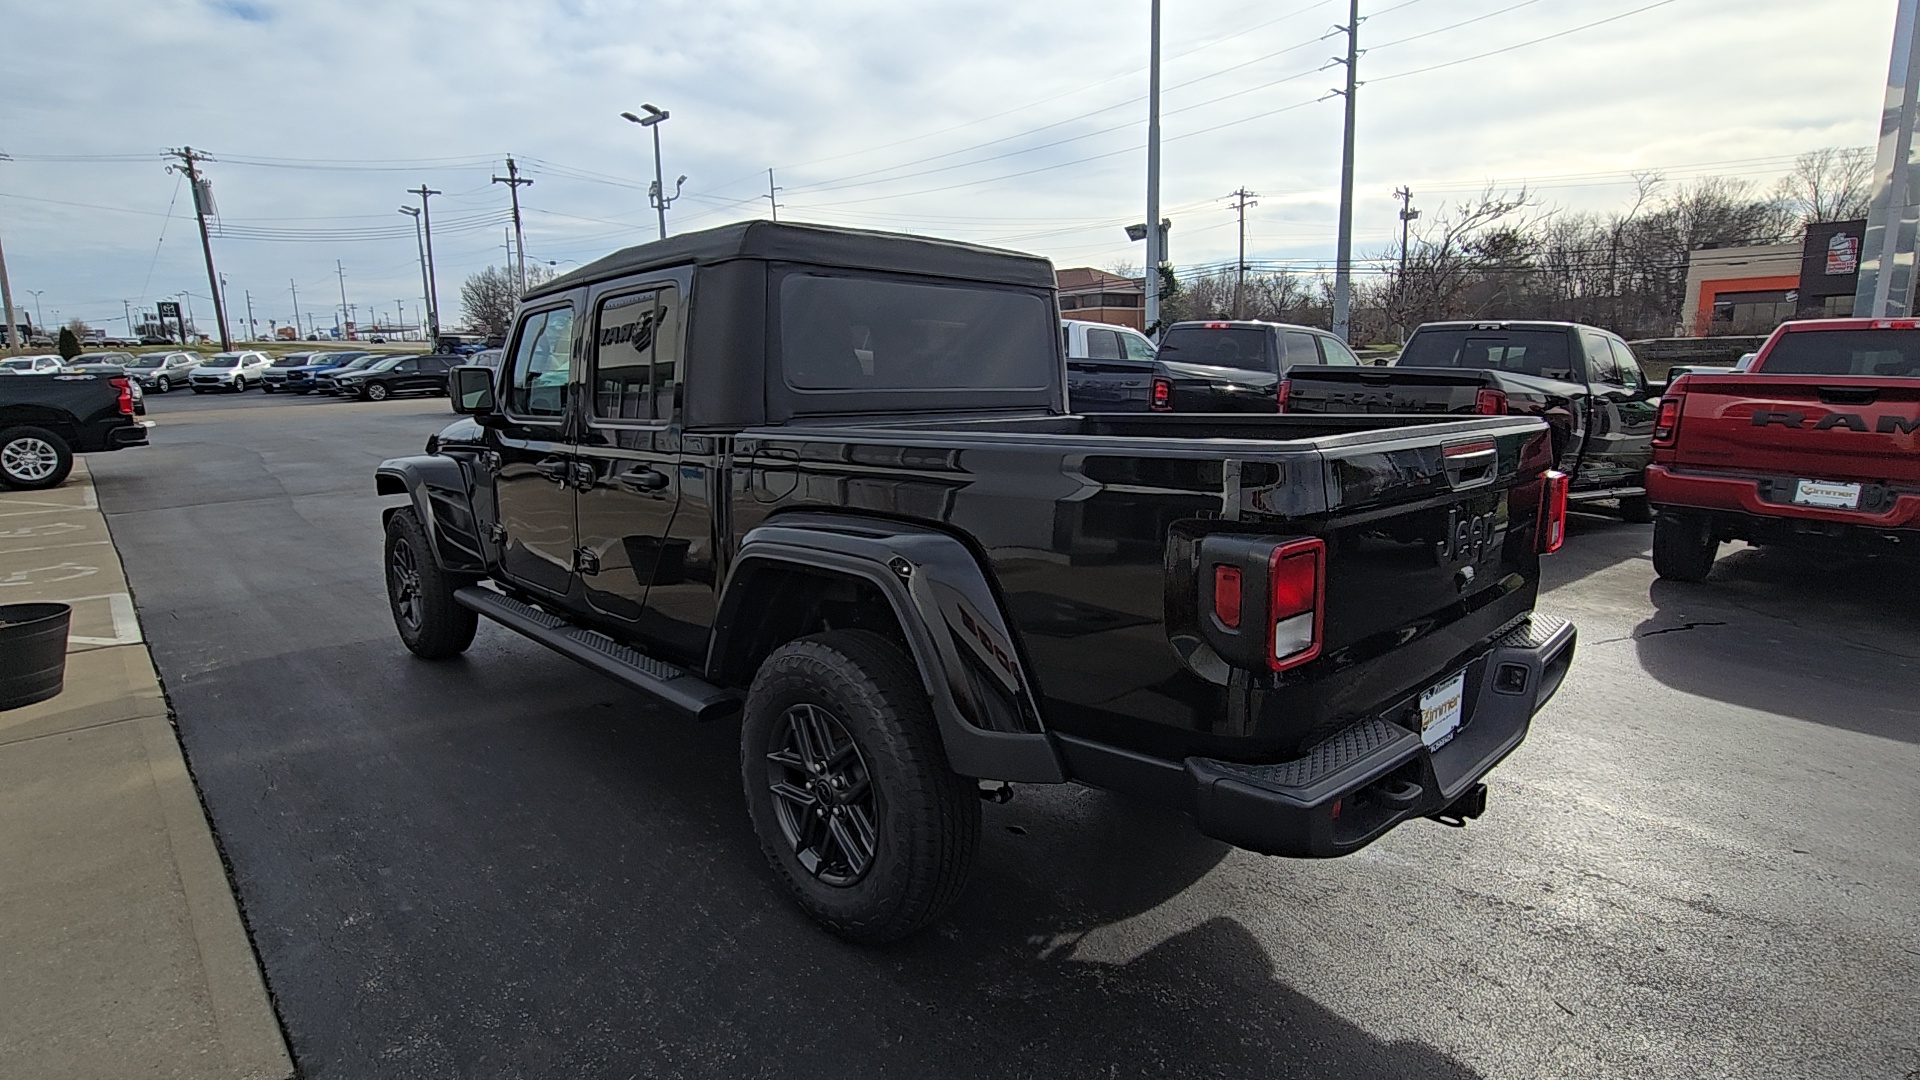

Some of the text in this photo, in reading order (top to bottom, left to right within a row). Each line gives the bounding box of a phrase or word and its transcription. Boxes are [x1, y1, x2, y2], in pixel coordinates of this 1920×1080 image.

[1325, 392, 1428, 408] RAM
[1751, 410, 1920, 434] RAM
[1436, 509, 1496, 564] Jeep
